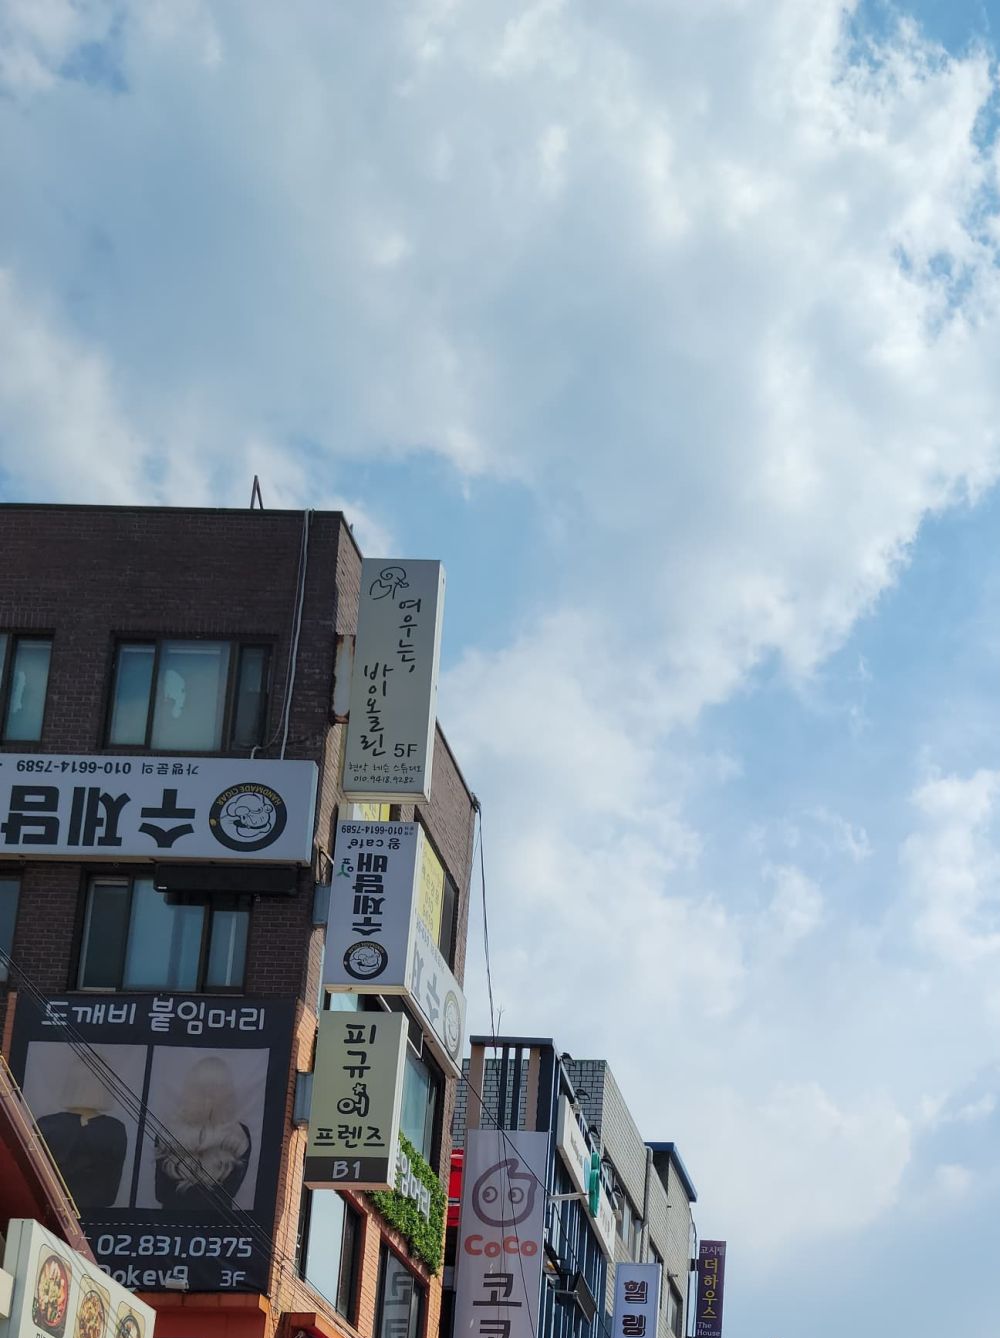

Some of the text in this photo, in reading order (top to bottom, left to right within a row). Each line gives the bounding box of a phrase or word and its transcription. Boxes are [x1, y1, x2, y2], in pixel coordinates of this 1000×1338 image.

[360, 662, 394, 757] 바이올린
[394, 743, 418, 758] 5F
[16, 759, 199, 776] 가맹문의 010-6614-7589
[341, 825, 403, 836] 010-6614-7589
[352, 853, 389, 937] 수제담배
[41, 997, 265, 1035] 도깨비 붙임머리
[313, 1124, 385, 1149] 프렌즈
[332, 1160, 361, 1179] B1
[96, 1234, 253, 1259] 02.831.0375
[219, 1270, 246, 1287] 3F
[701, 1258, 719, 1319] 더하우스
[697, 1329, 720, 1337] House
